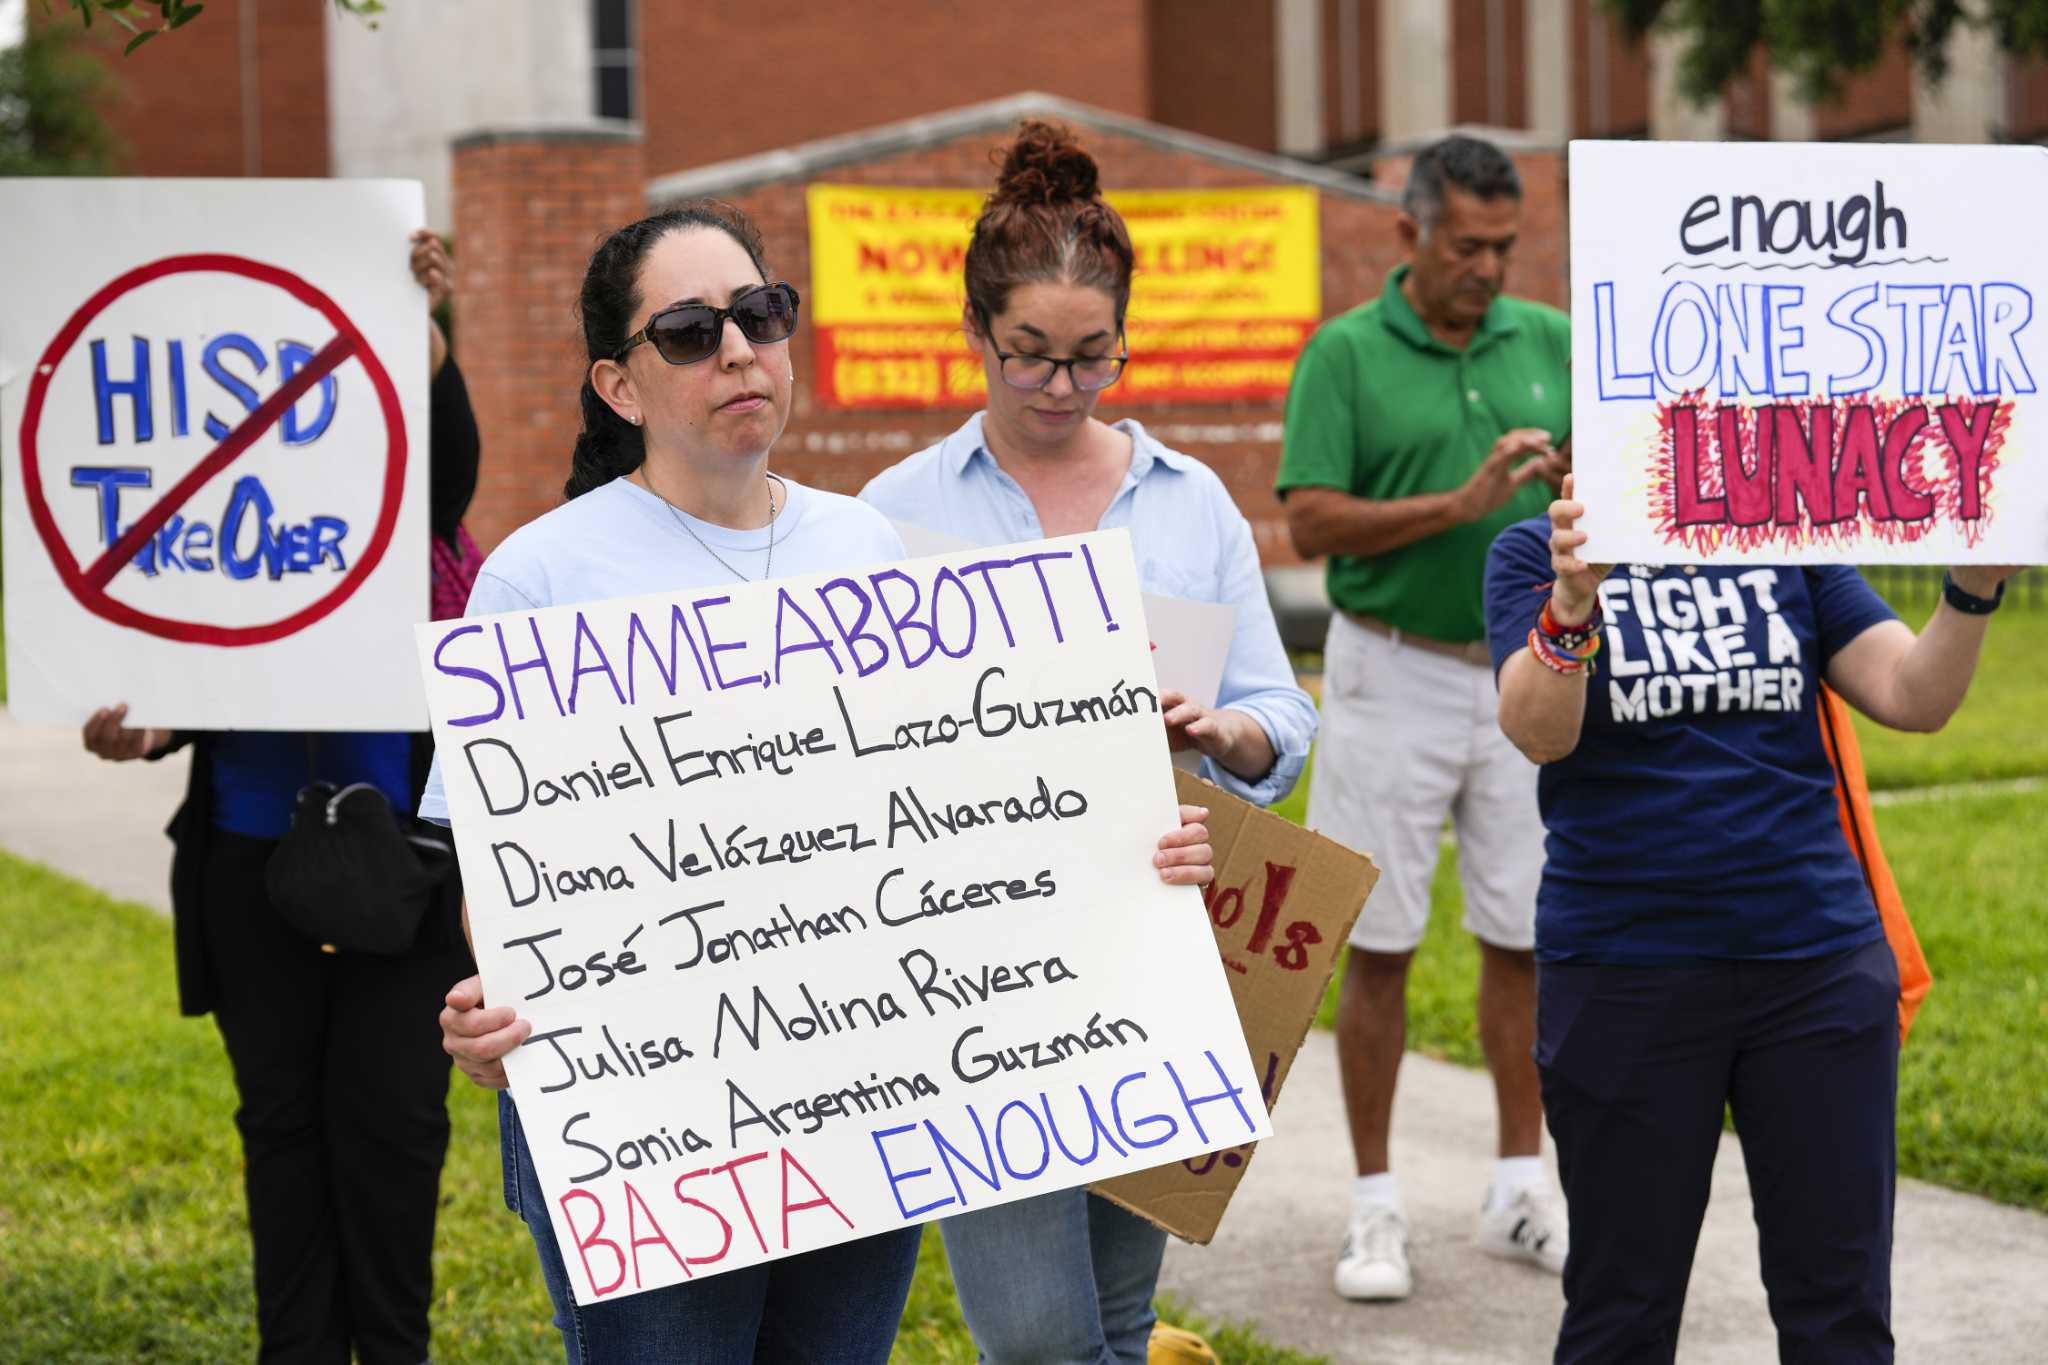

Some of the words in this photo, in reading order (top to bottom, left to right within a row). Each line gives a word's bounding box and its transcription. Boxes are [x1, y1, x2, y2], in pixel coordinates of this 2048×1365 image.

[1680, 180, 1907, 264] enough
[89, 331, 337, 445] HISD
[1594, 281, 1810, 401] LONE
[1826, 281, 2037, 397] STAR
[1671, 402, 1998, 528] LUNACY
[1599, 568, 1778, 631] FIGHT
[1606, 624, 1757, 678] LIKE
[1766, 612, 1801, 665] A
[463, 735, 656, 816] Daniel
[654, 709, 838, 789] Enrique
[832, 666, 1158, 759] Lazo-Guzmán
[1608, 667, 1804, 723] MOTHER
[491, 840, 635, 909] Diana
[629, 816, 877, 886] Velázquez
[886, 775, 1088, 850] Alvarado
[502, 925, 648, 1002] José
[658, 896, 868, 973] Jonathan
[874, 865, 1058, 928] Cáceres
[521, 1025, 694, 1095] Julisa
[712, 982, 908, 1061] Molina
[897, 947, 1079, 1018] Rivera
[560, 1111, 714, 1185] Sonia
[726, 1079, 940, 1150] Argentina
[950, 1010, 1149, 1085] Guzmán
[558, 1146, 856, 1297] BASTA
[870, 1050, 1258, 1221] ENOUGH
